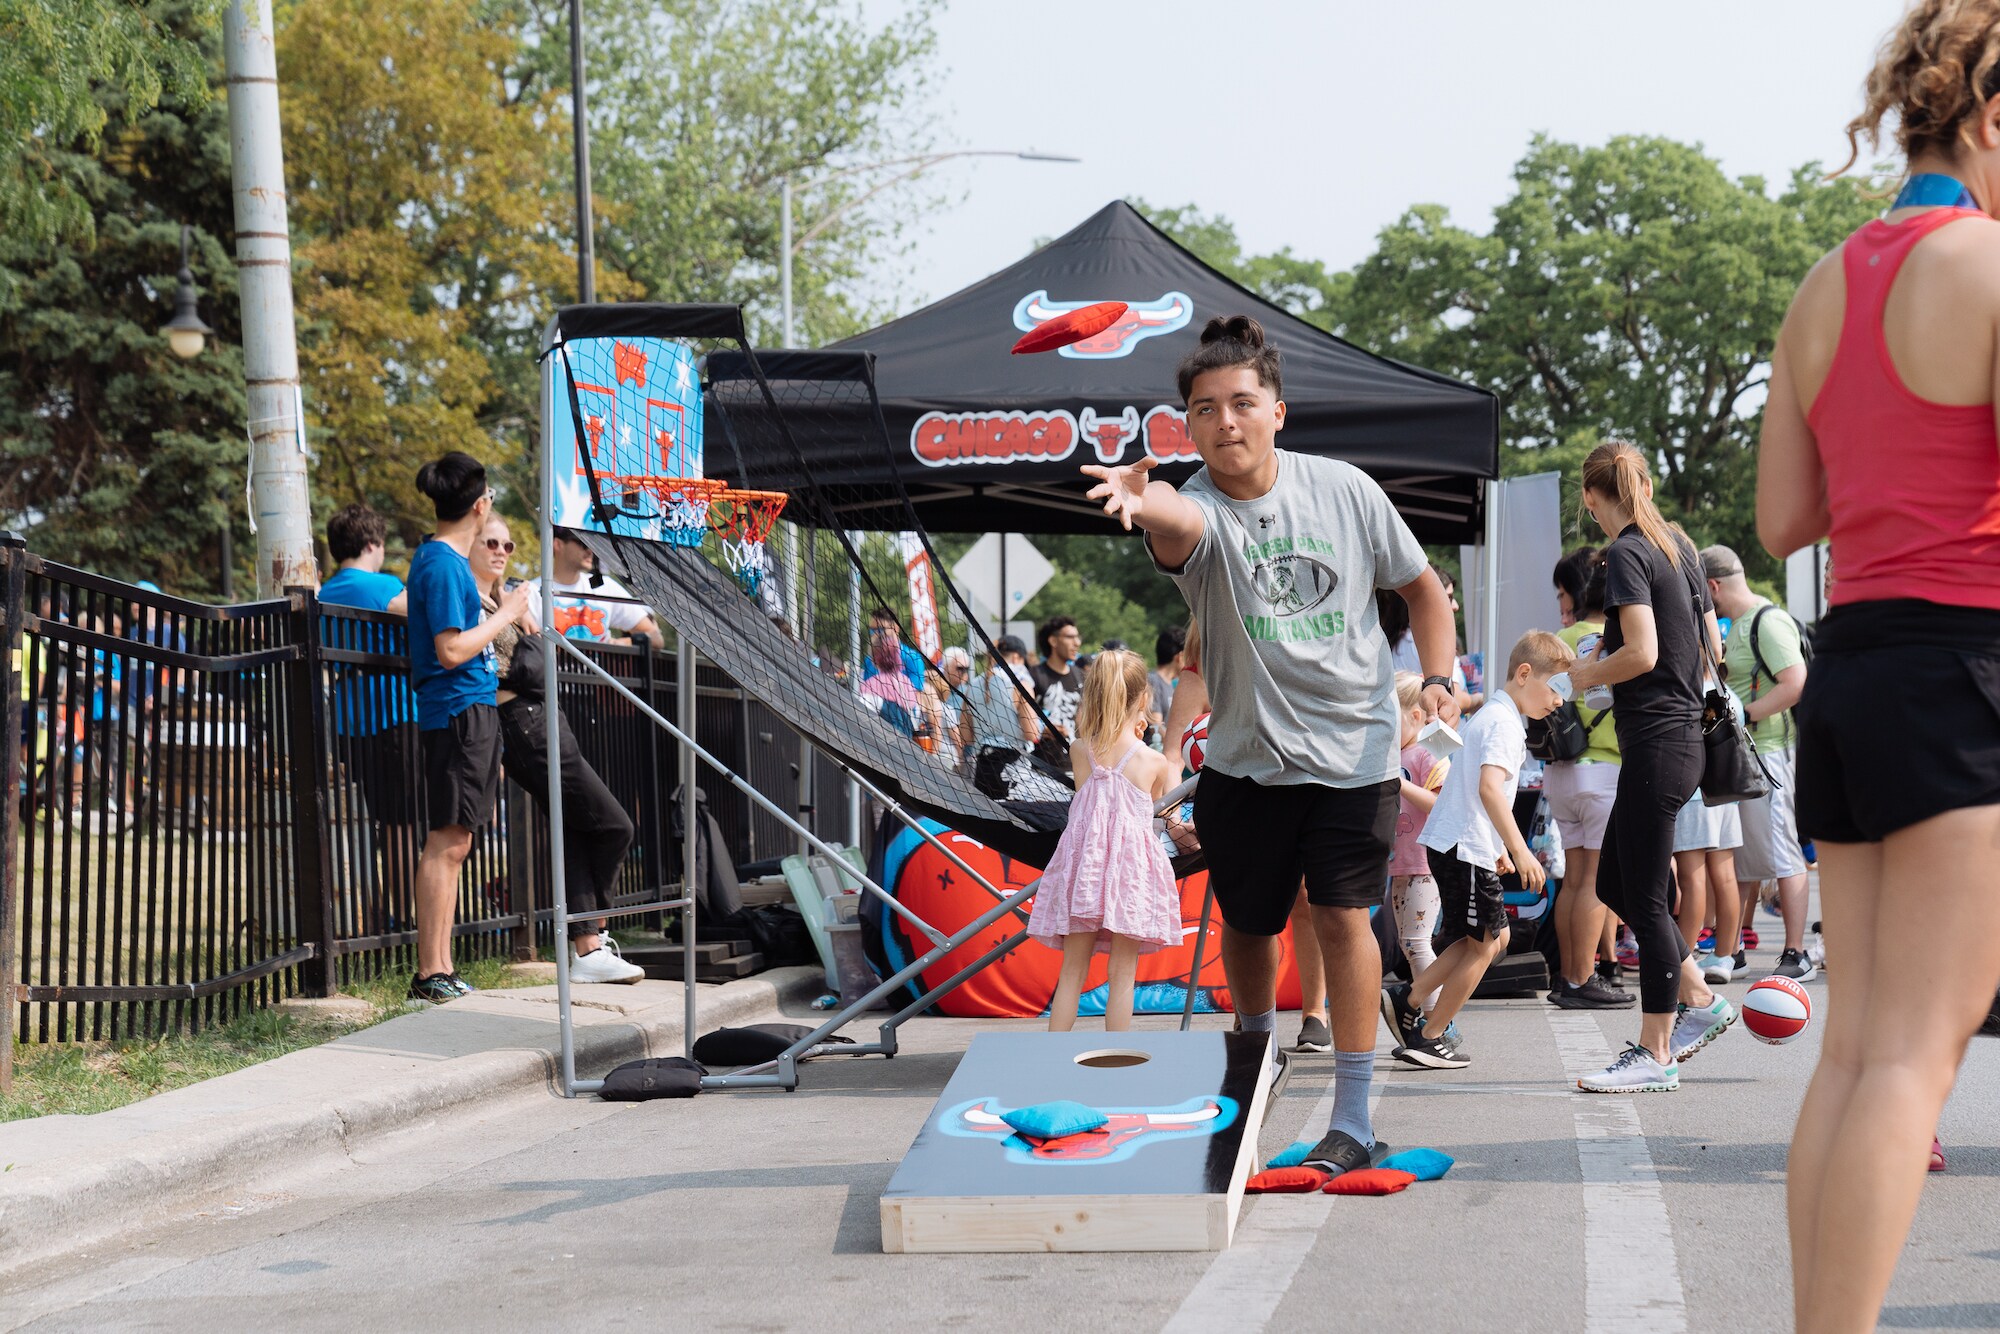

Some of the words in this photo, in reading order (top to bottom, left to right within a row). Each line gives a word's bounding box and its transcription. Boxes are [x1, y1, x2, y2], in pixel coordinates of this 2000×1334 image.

[913, 413, 1076, 464] CHICAGO
[1296, 537, 1336, 559] PARK
[1244, 610, 1345, 643] MUSTANGS
